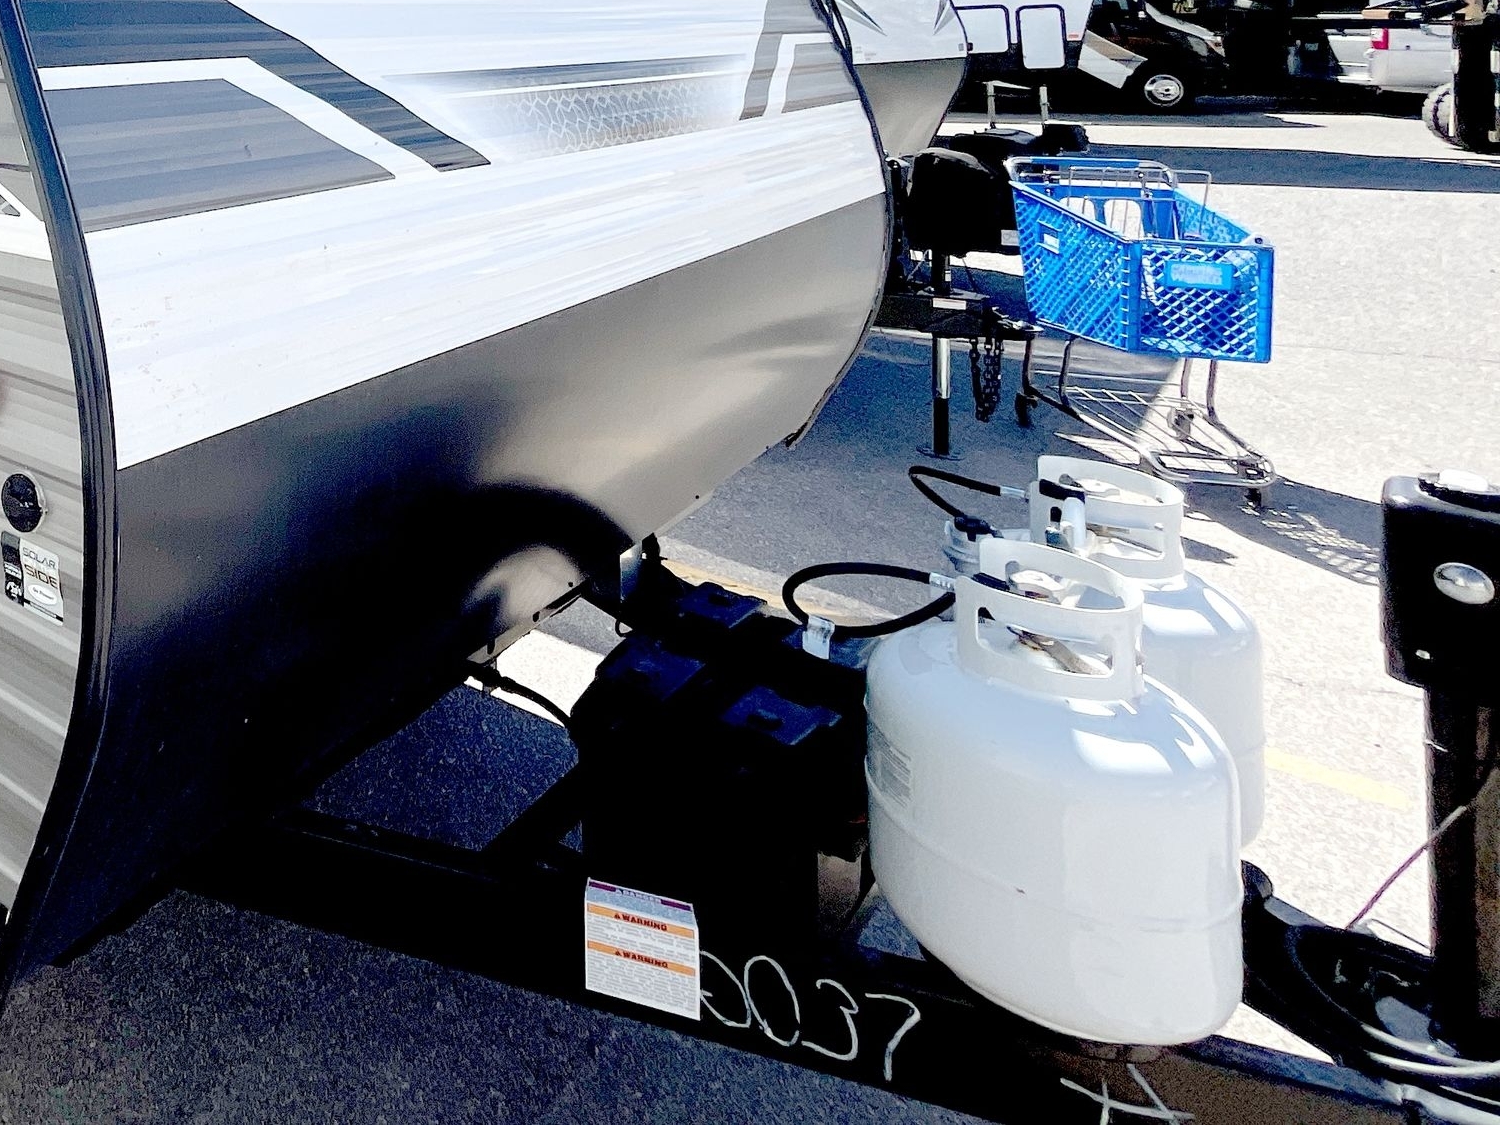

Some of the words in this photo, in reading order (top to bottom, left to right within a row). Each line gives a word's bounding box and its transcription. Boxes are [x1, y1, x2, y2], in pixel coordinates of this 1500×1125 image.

[22, 546, 57, 570] SOLAR
[24, 563, 59, 590] SIDE
[622, 914, 668, 932] WARNING
[622, 951, 669, 969] WARNING
